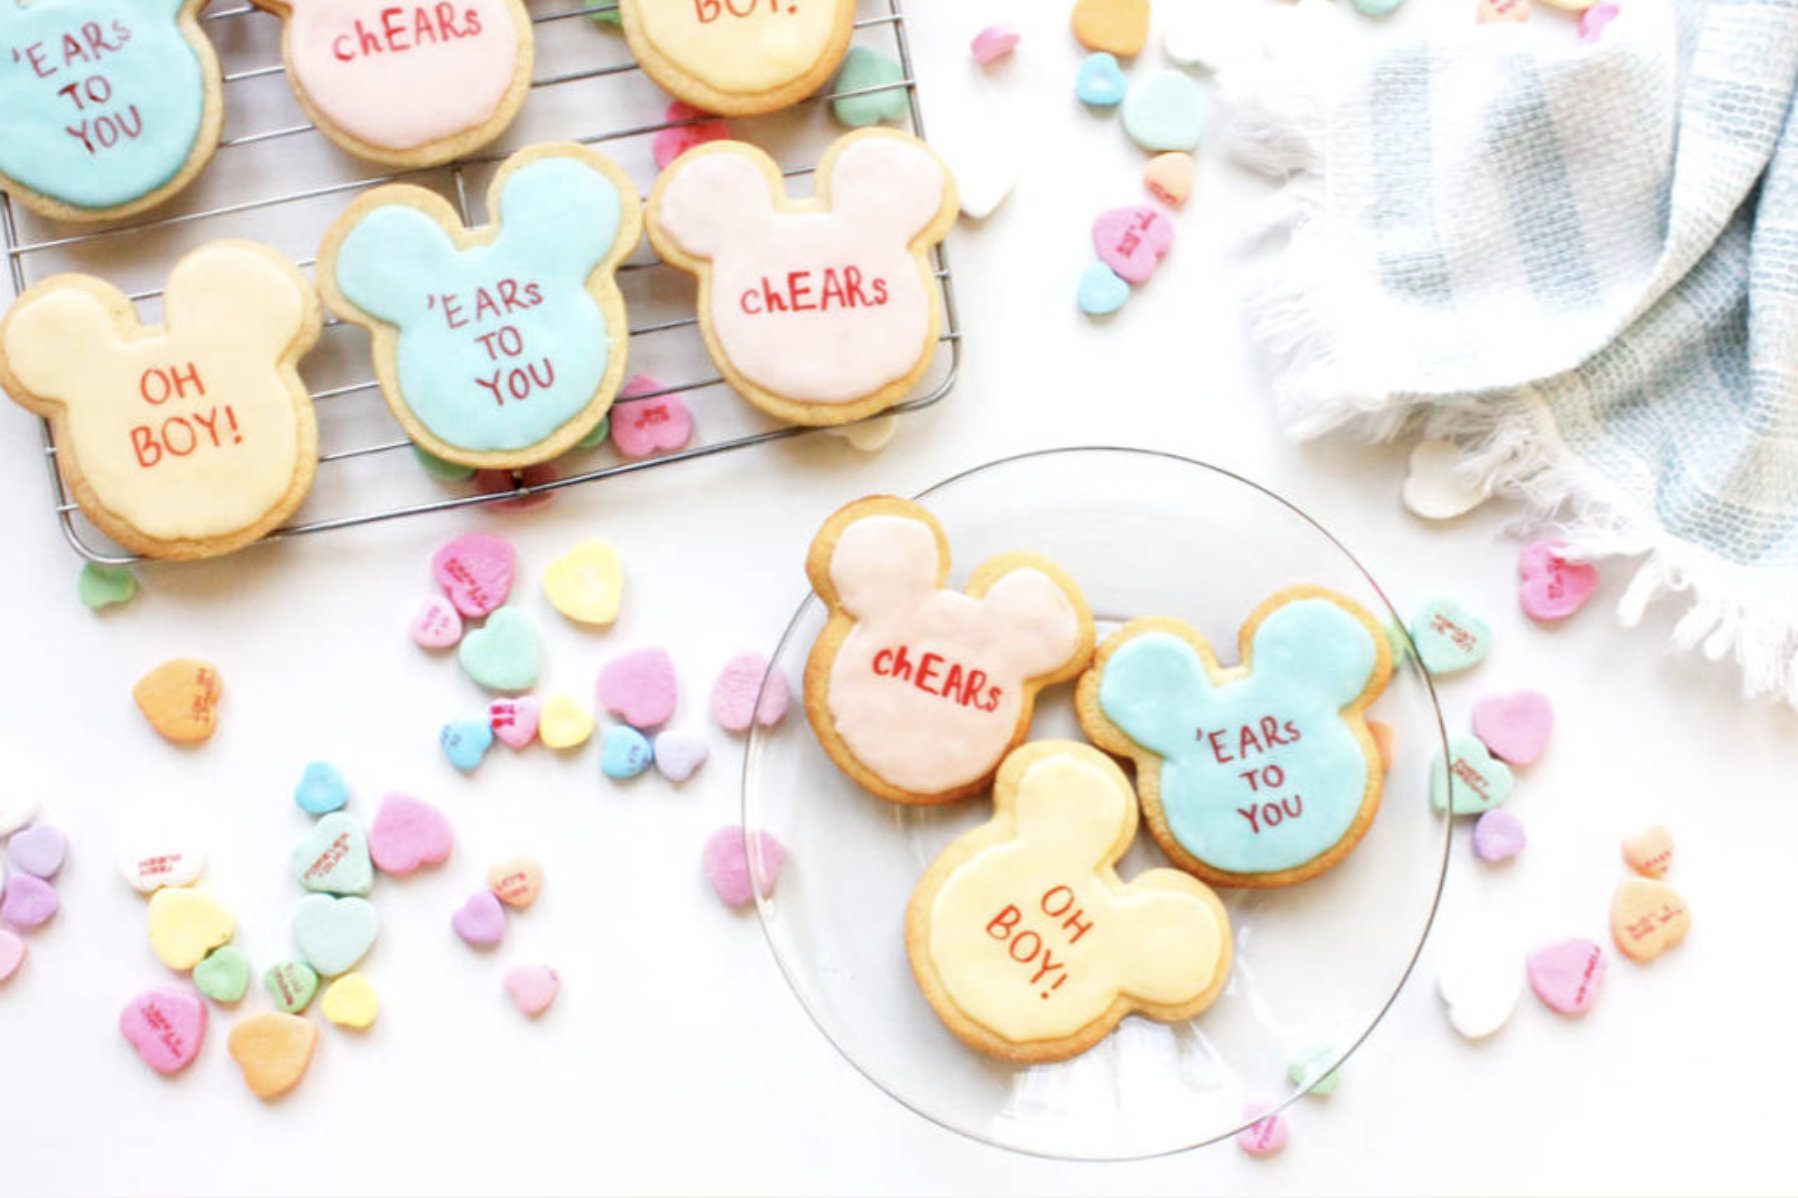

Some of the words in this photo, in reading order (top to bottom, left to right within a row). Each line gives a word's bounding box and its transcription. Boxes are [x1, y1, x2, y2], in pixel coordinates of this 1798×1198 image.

[11, 19, 131, 79] 'EARs
[332, 2, 483, 62] chEARs
[57, 74, 112, 110] TO
[65, 104, 142, 154] YOU
[427, 278, 544, 329] 'EARs
[740, 265, 889, 315] chEARs
[475, 325, 524, 362] TO
[140, 361, 207, 405] OH
[475, 357, 556, 405] YOU
[129, 405, 244, 469] BOY!
[872, 646, 1003, 713] chEARs
[1196, 716, 1302, 765] 'EARs
[1240, 765, 1286, 793] TO
[1237, 795, 1304, 835] YOU
[1040, 885, 1095, 945] OH
[985, 904, 1069, 1000] BOY!
